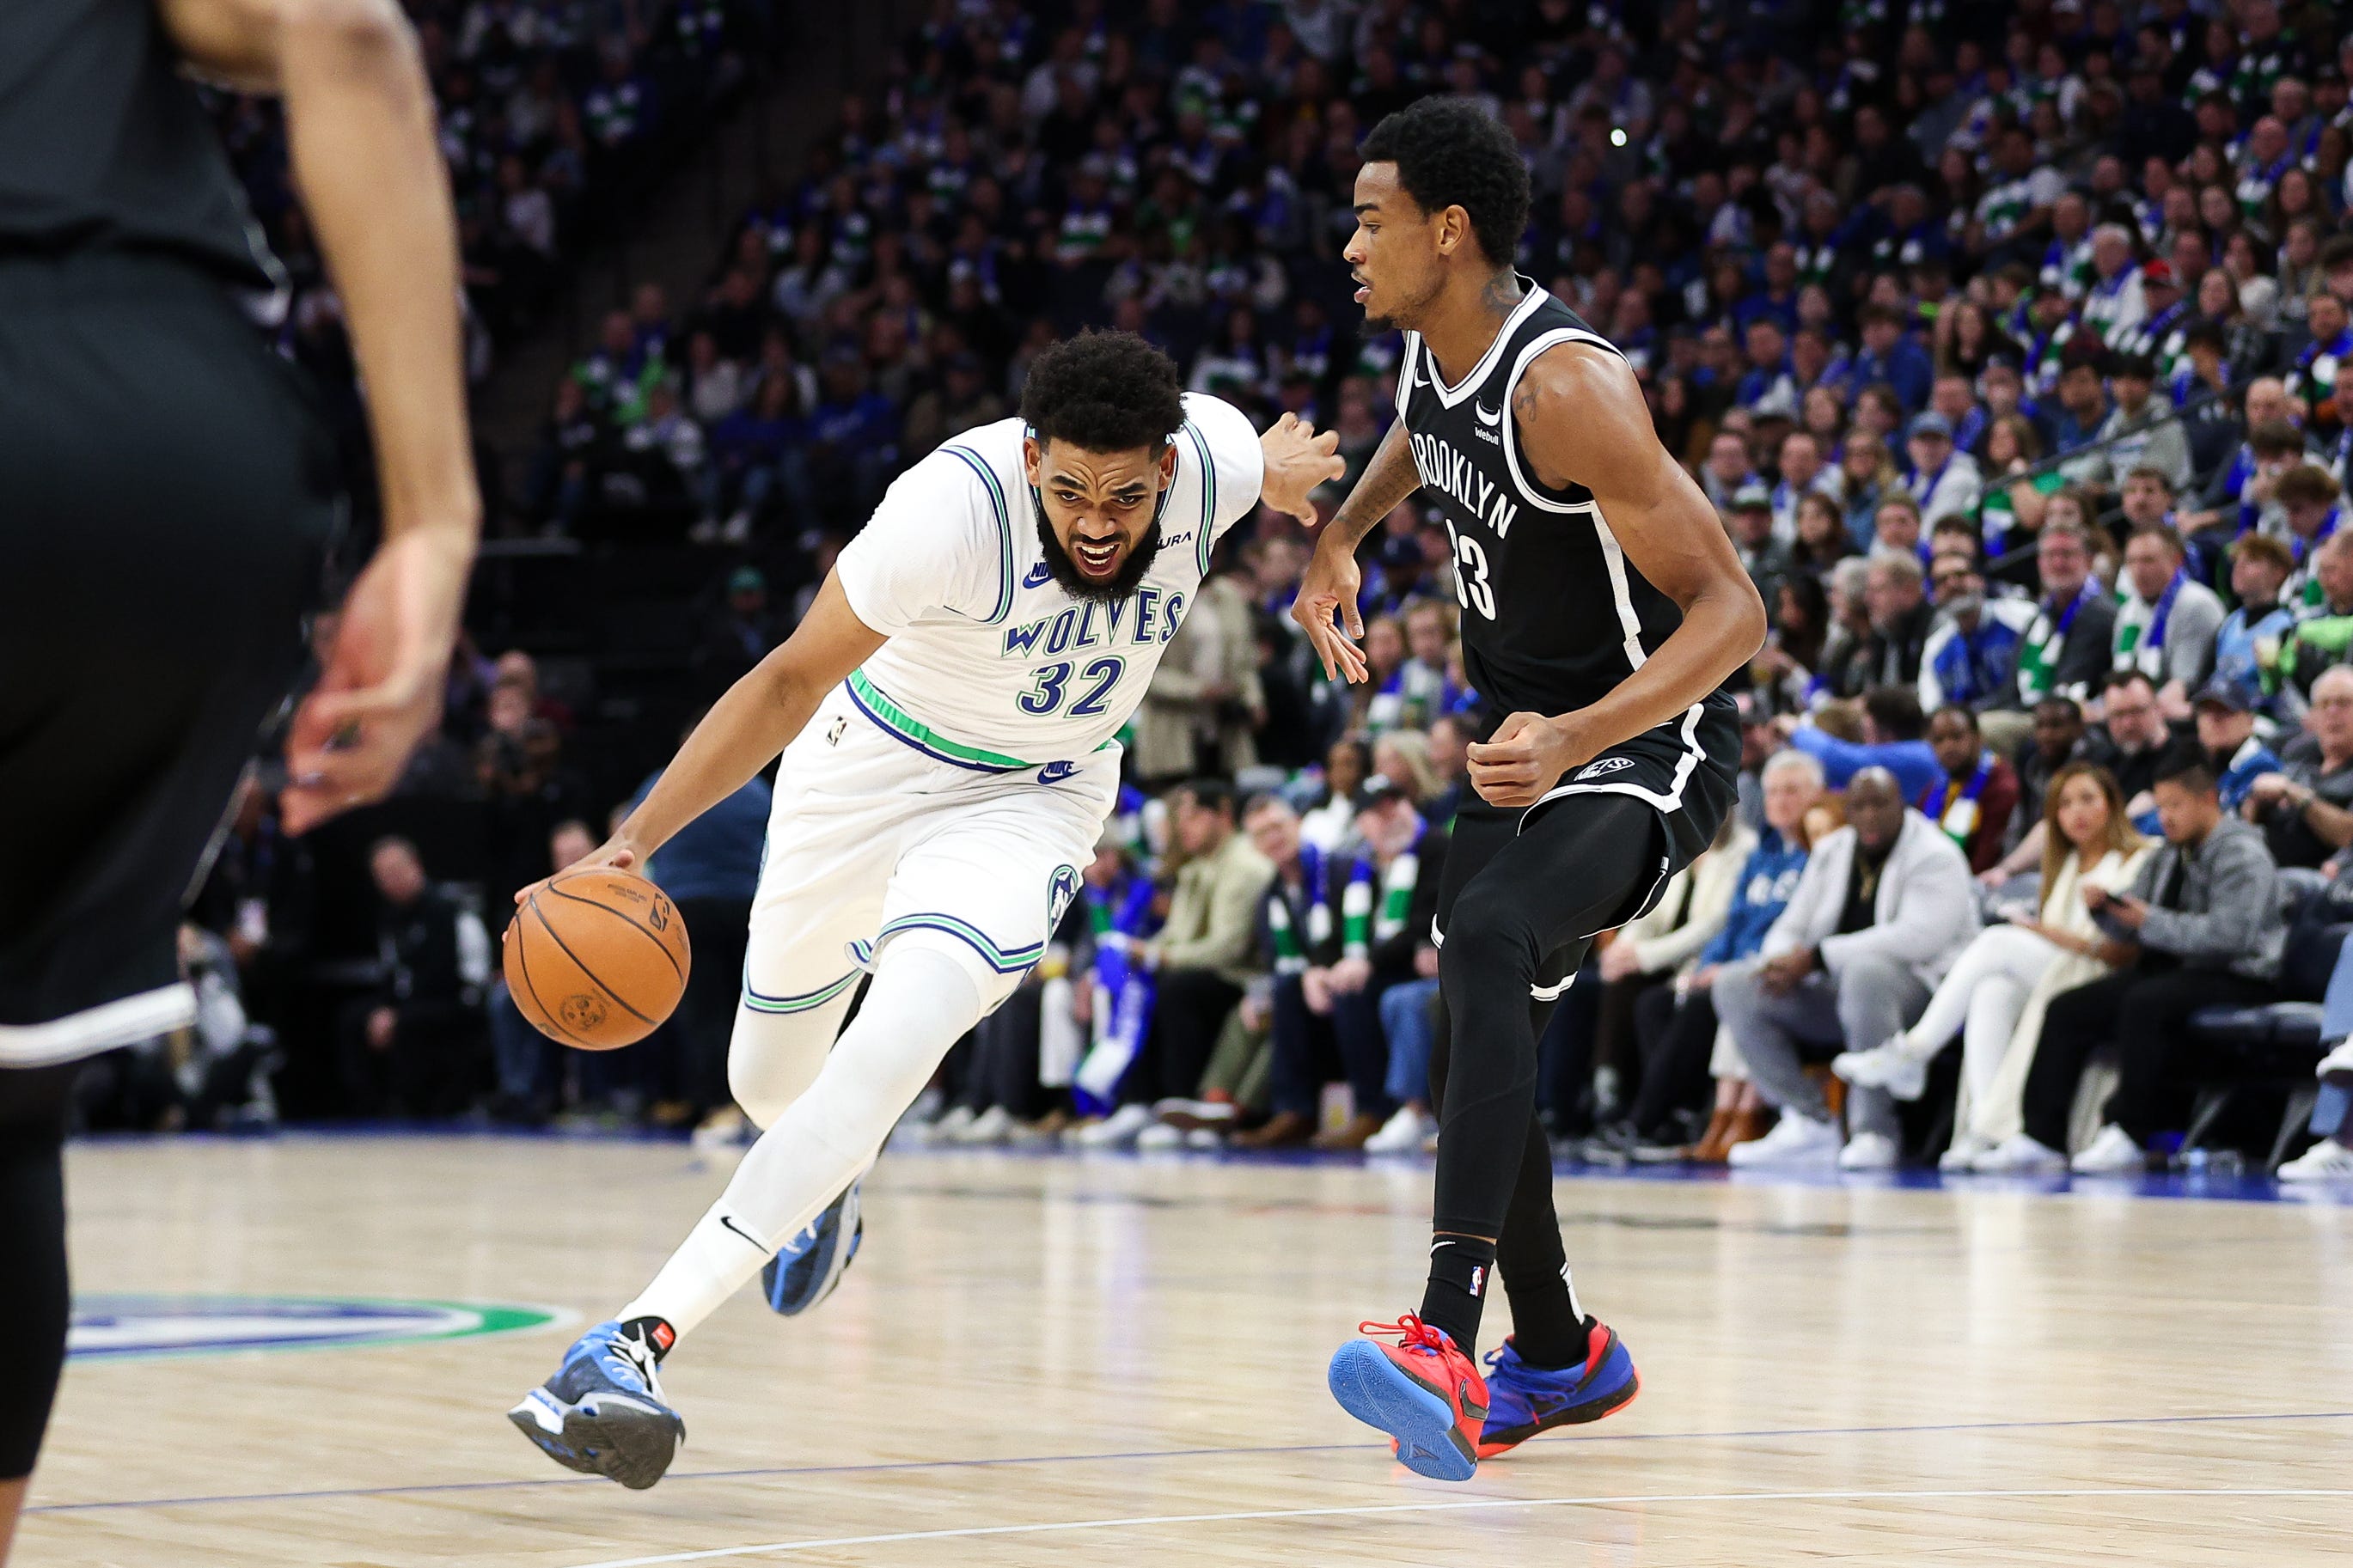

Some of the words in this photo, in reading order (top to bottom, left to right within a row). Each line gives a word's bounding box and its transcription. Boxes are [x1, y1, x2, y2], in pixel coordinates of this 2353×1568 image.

[1475, 426, 1499, 446] Webull
[1001, 585, 1185, 658] WOLVES
[1016, 655, 1126, 719] 32
